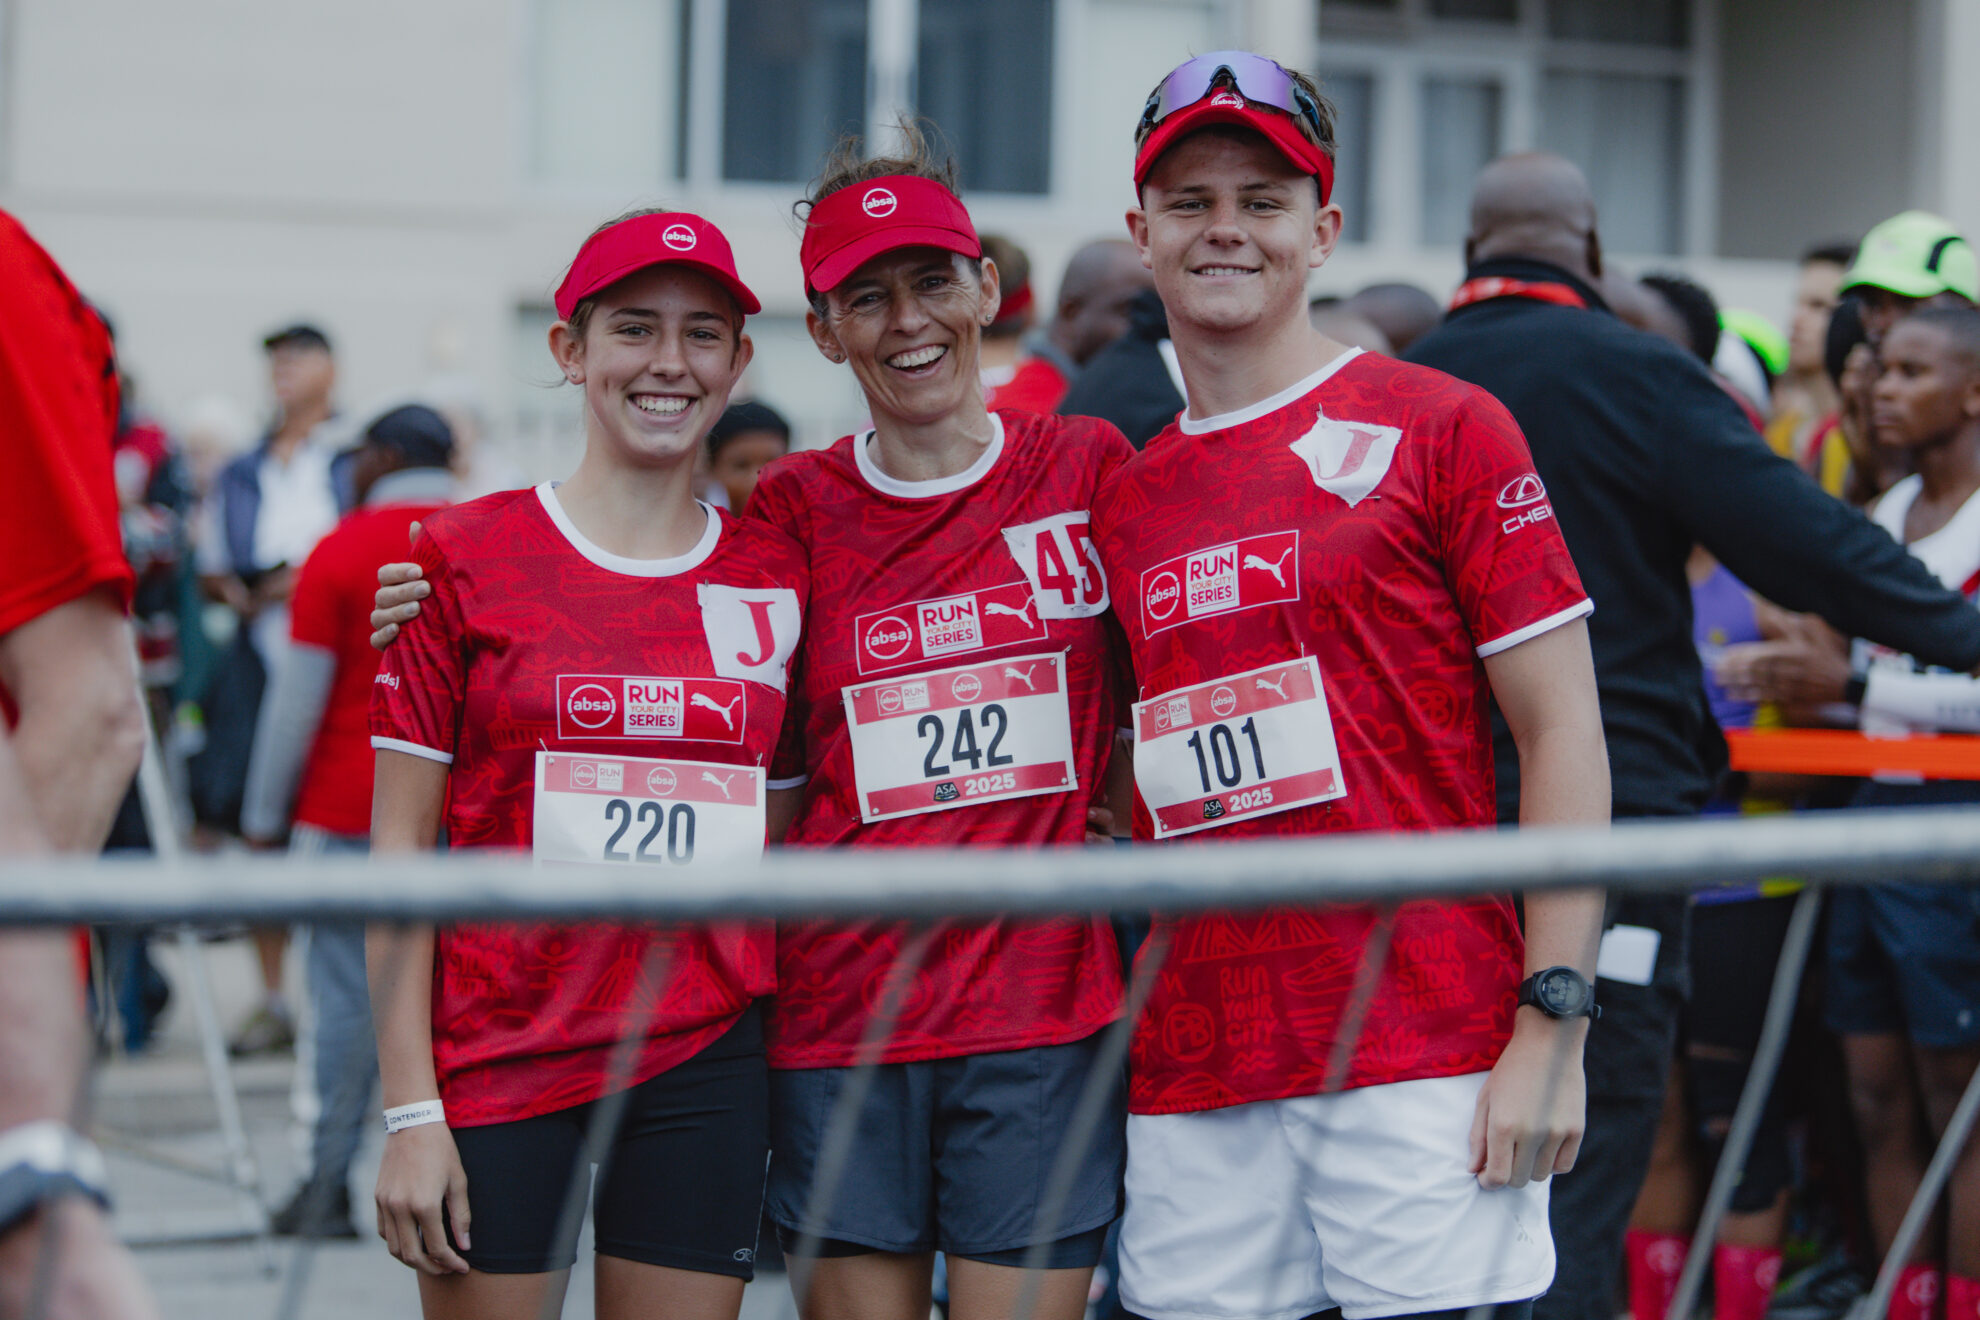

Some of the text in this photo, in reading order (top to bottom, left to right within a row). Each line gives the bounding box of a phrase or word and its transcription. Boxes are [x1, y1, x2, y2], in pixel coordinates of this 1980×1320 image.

[867, 197, 893, 209] absa
[666, 231, 693, 243] absa
[1315, 428, 1382, 481] J
[1036, 522, 1104, 605] 45
[1190, 551, 1234, 582] RUN
[1190, 575, 1232, 591] YOUR CITY
[1150, 586, 1176, 606] absa
[1190, 585, 1232, 606] SERIES
[922, 601, 974, 627] RUN
[736, 600, 775, 667] J
[926, 620, 972, 635] YOUR CITY
[870, 630, 907, 646] absa
[926, 628, 974, 647] SERIES
[628, 684, 680, 704] RUN
[903, 686, 925, 697] RUN
[955, 682, 978, 693] absa
[573, 696, 611, 711] absa
[630, 705, 677, 714] YOUR CITY
[1170, 702, 1187, 713] RUN
[1214, 696, 1233, 707] absa
[628, 714, 676, 727] SERIES
[917, 703, 1014, 778] 242
[1187, 716, 1266, 793] 101
[599, 768, 620, 777] RUN
[650, 774, 673, 786] absa
[935, 772, 1016, 796] ASA 2025
[1204, 787, 1274, 813] ASA 2025
[603, 798, 696, 867] 220
[389, 1109, 432, 1124] CONTENDER
